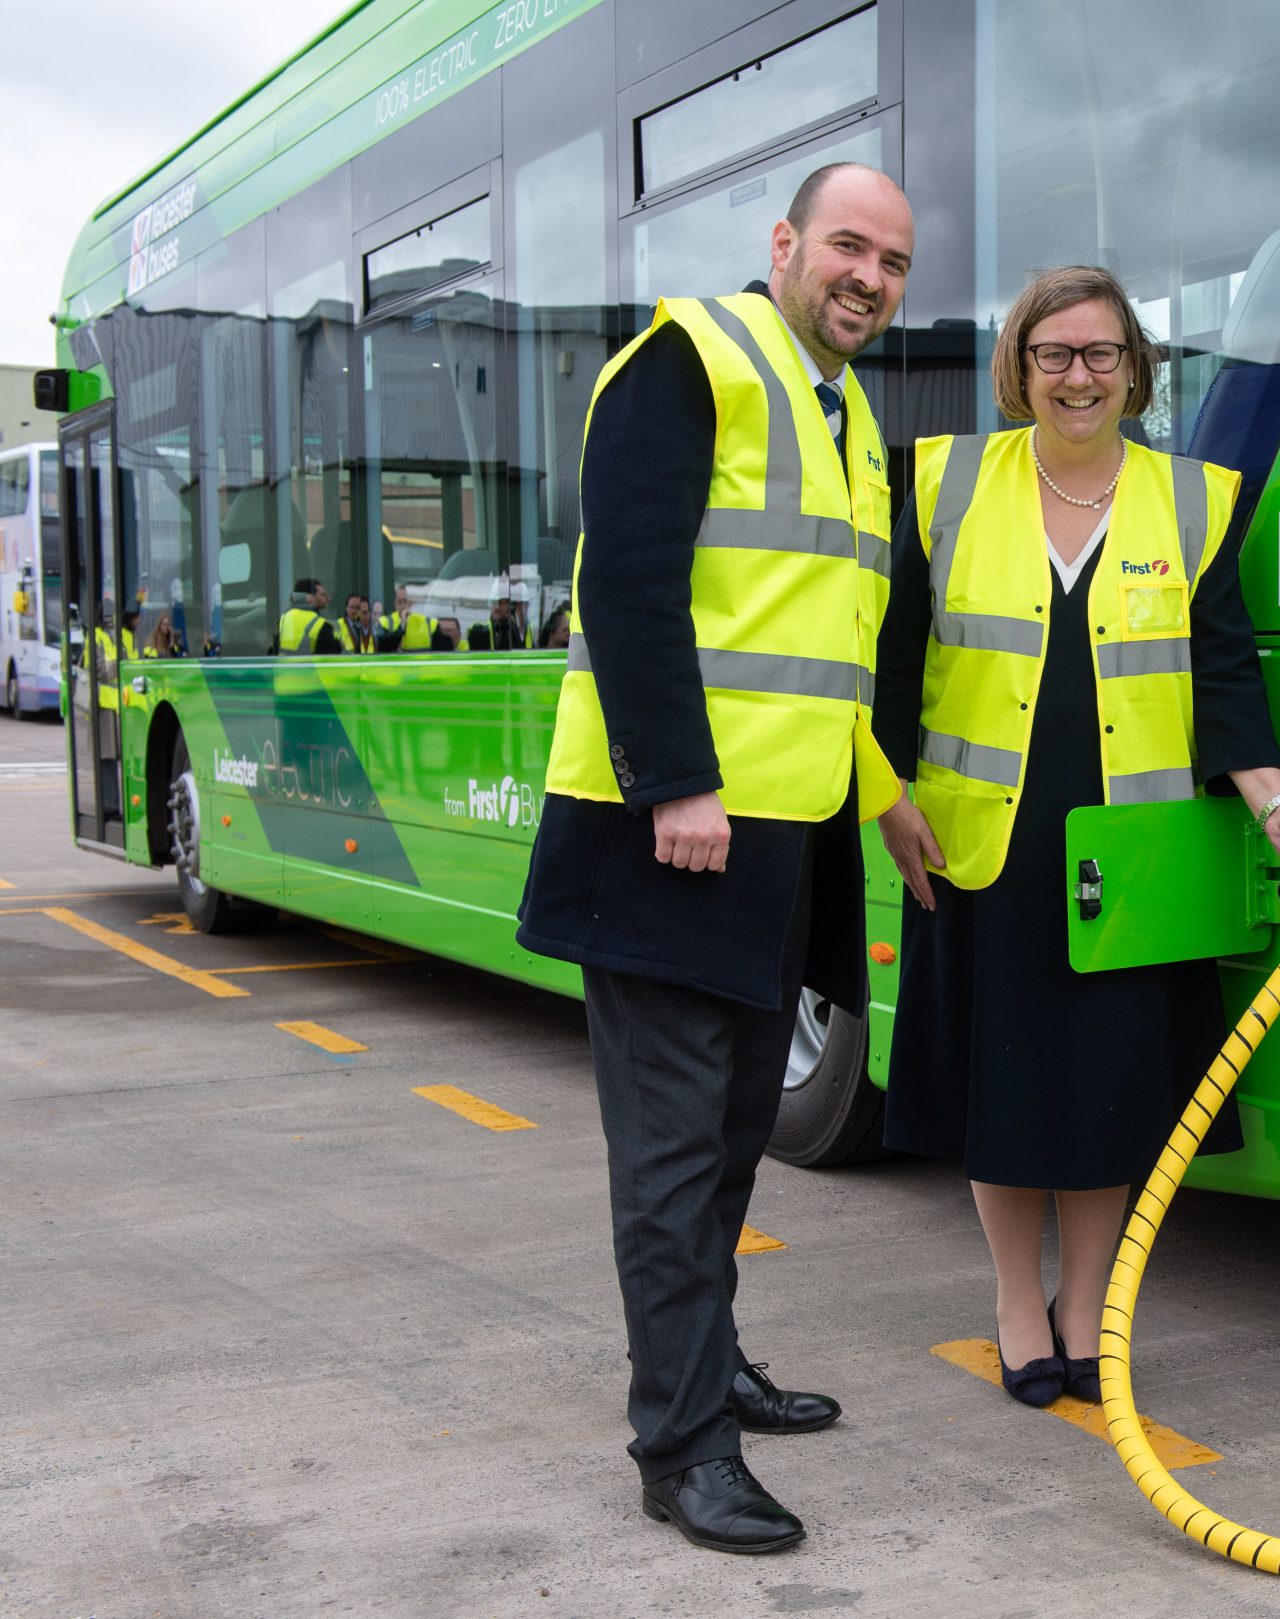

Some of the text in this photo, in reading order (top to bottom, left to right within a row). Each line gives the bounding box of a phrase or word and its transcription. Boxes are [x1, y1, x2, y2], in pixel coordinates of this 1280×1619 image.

[375, 0, 538, 126] 100% ELECTRIC ZERO
[1121, 560, 1151, 575] First
[214, 748, 258, 788] Leicester
[444, 779, 546, 828] from First Bu
